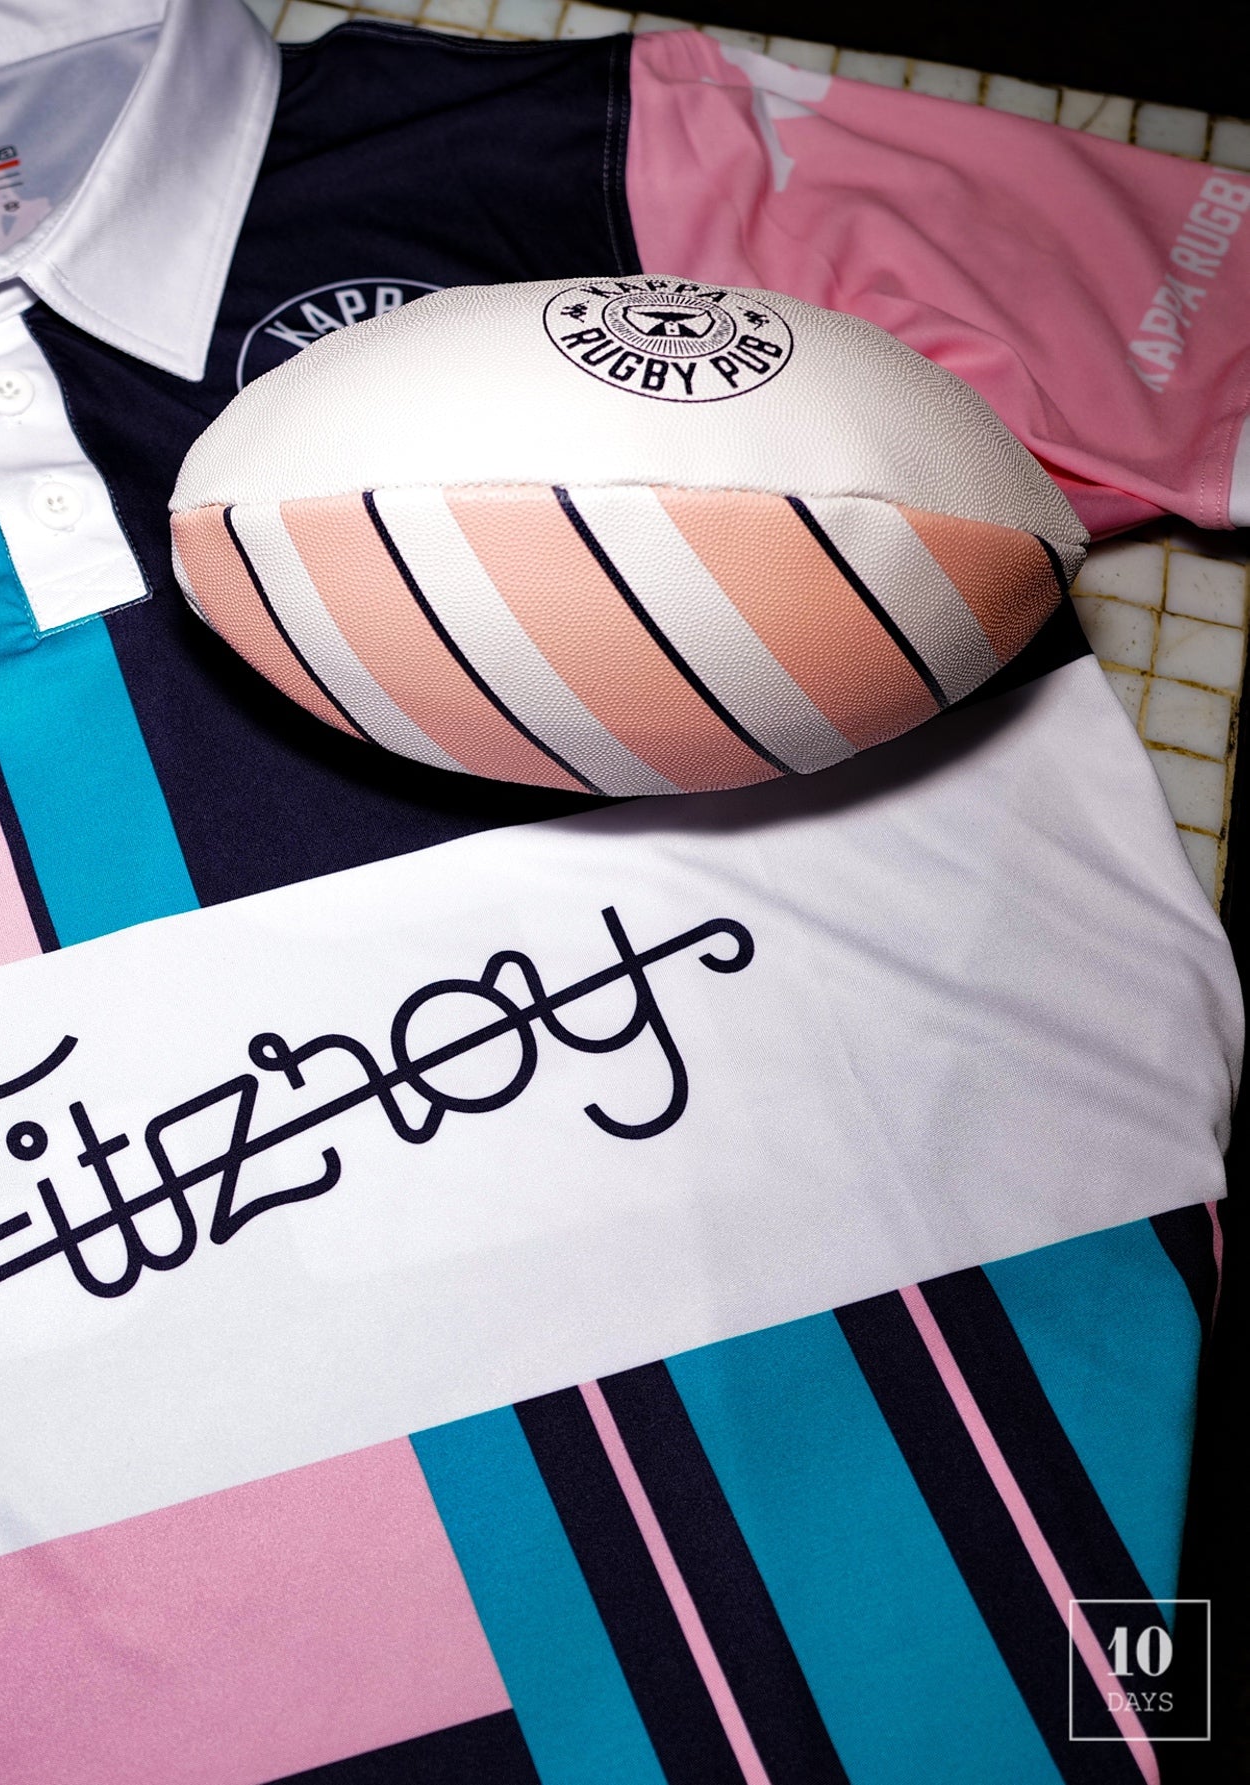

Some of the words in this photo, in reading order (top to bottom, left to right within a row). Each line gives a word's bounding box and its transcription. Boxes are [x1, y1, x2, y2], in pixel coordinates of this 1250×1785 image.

[581, 280, 728, 302] KAPPA
[1126, 274, 1206, 393] KAPPA
[1170, 166, 1250, 278] RUGB
[264, 286, 405, 349] KAPP
[561, 327, 697, 395] RUGBY
[710, 335, 783, 388] PUB
